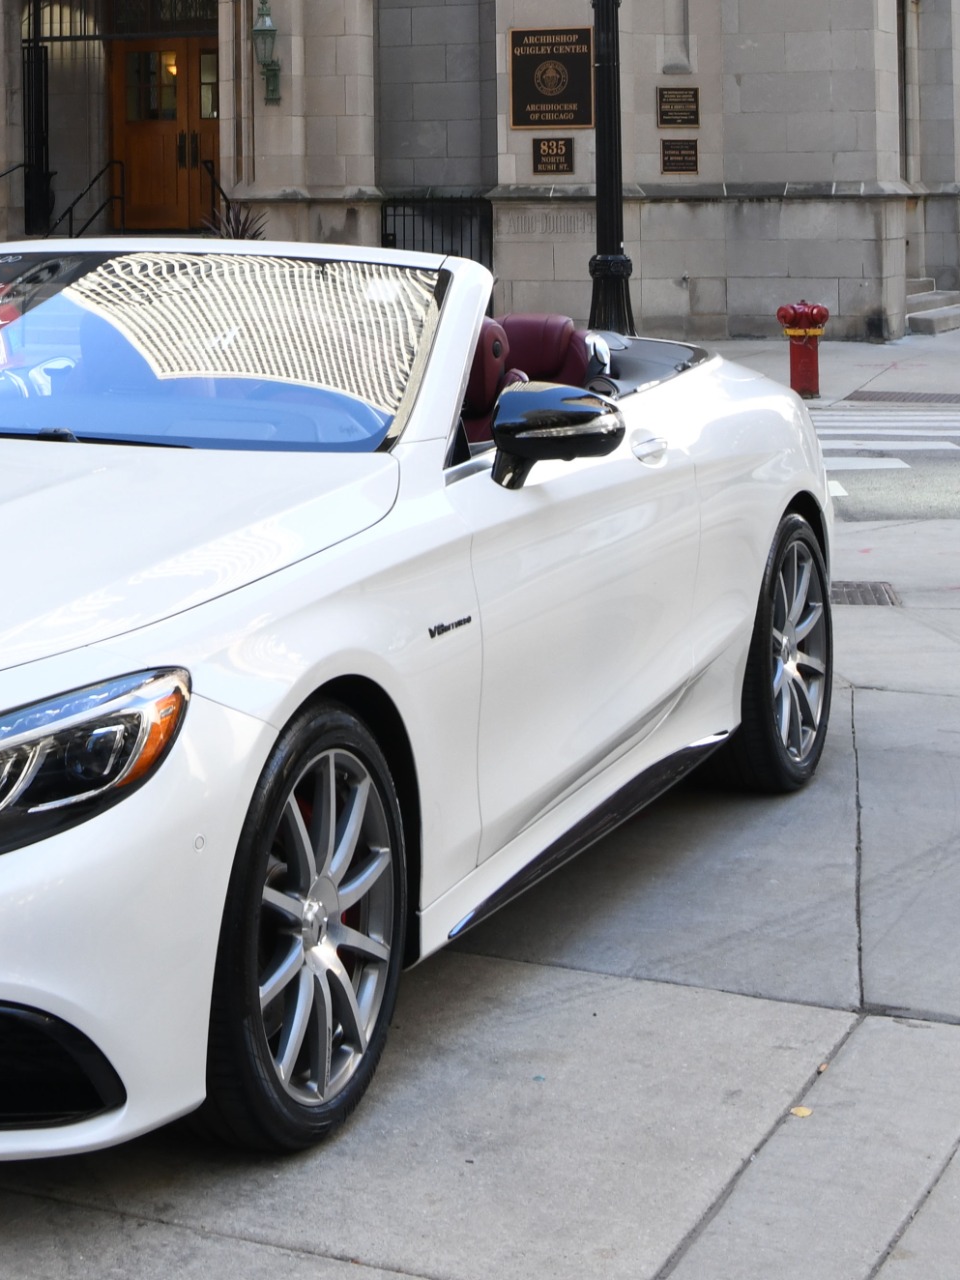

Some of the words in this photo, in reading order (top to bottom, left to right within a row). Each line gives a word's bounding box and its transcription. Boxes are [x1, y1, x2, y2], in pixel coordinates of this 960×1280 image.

[523, 34, 579, 45] ARCHBISHOP
[514, 46, 552, 56] QUIGLEY
[553, 45, 588, 54] CENTER
[525, 103, 578, 112] ARCHDIOCESE
[529, 113, 540, 121] OF
[540, 112, 574, 121] CHICAGO
[540, 140, 566, 155] 835
